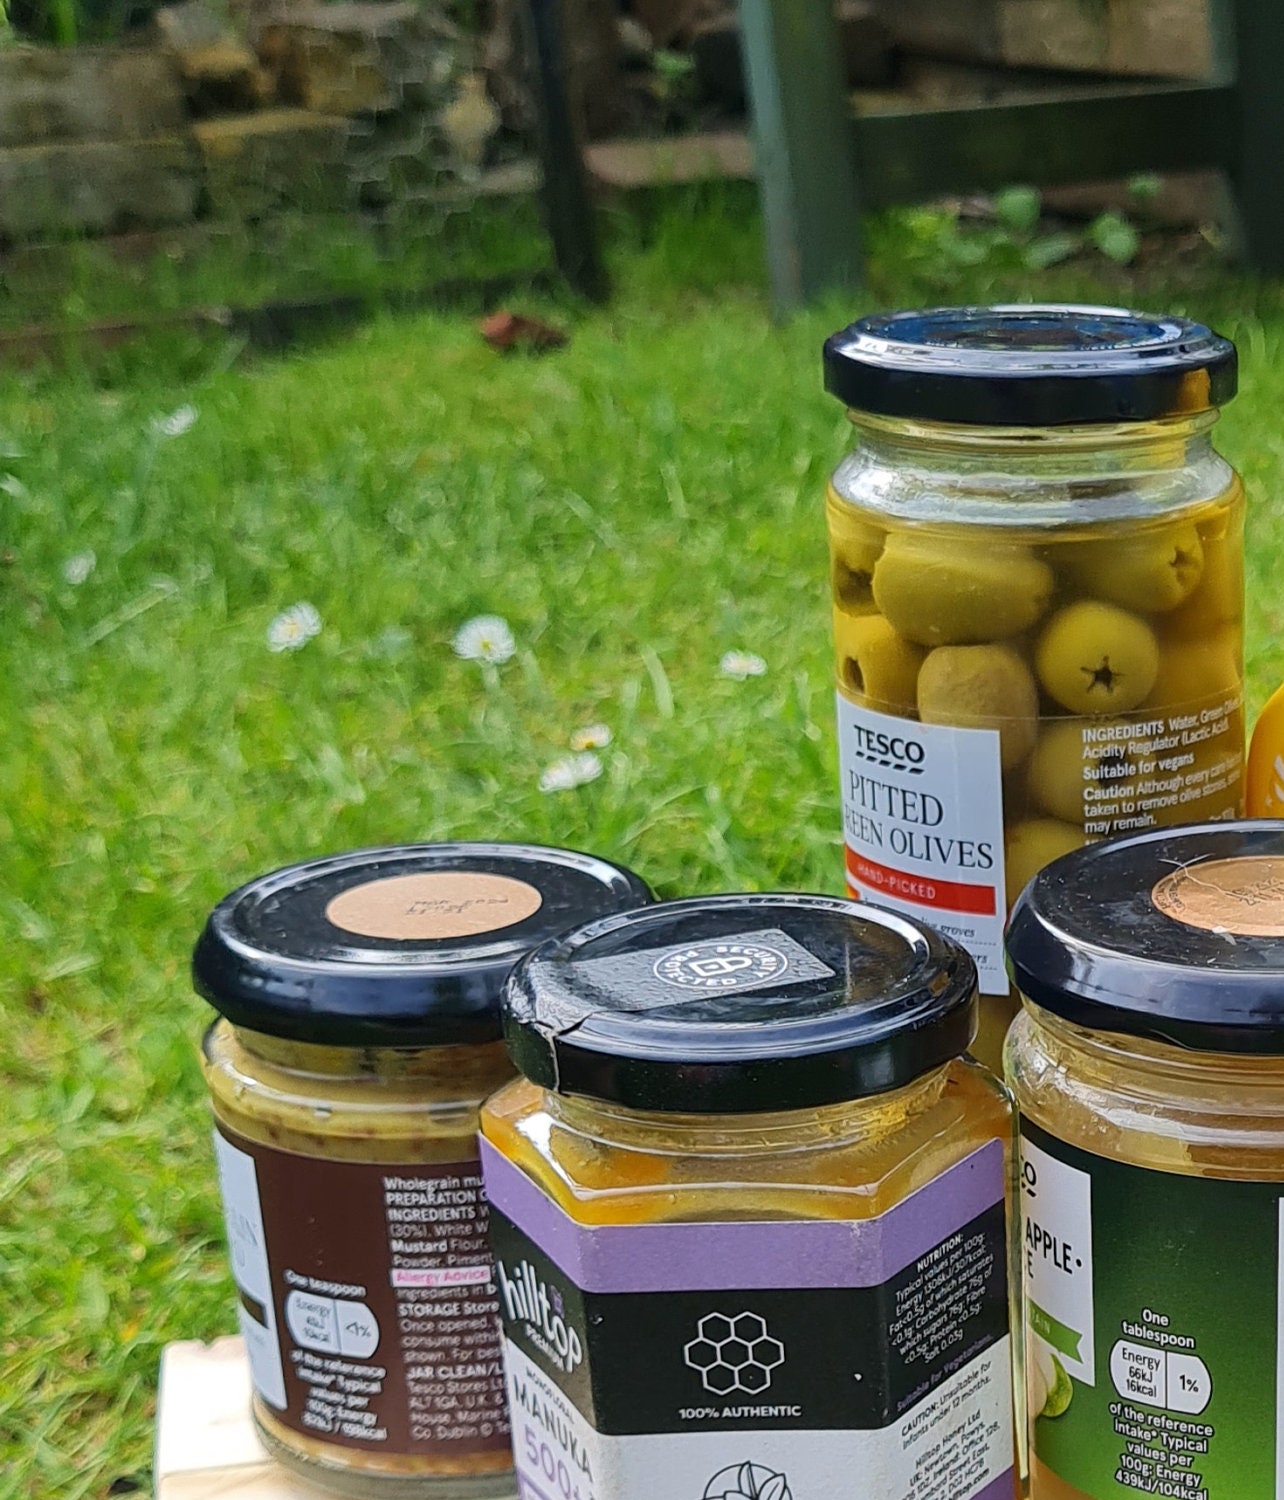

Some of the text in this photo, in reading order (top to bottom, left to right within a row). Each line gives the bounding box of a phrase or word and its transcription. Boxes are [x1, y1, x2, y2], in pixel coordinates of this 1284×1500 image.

[1082, 721, 1164, 742] INGREDIENTS
[854, 724, 925, 764] TESCO
[1083, 735, 1180, 759] Acidity Regulator
[1083, 752, 1194, 780] Suitable for vegans
[849, 769, 943, 827] PITTED
[1084, 785, 1134, 801] Caution
[1136, 775, 1184, 796] Although
[1084, 803, 1119, 818] taken
[1122, 800, 1134, 813] to
[1137, 794, 1178, 811] remove
[1084, 814, 1157, 835] may remain.
[846, 804, 994, 870] REEN OLIVES
[857, 863, 936, 899] HAND-PICKED
[664, 950, 737, 986] PROTECTED
[716, 945, 778, 978] SECURITY
[384, 1176, 460, 1193] Wholegrain
[385, 1191, 476, 1205] PREPARATION
[388, 1206, 476, 1222] INGREDIENTS
[391, 1239, 447, 1253] Mustard
[917, 1234, 963, 1273] NUTRITION:
[399, 1301, 500, 1317] STORAGE Store
[498, 1259, 583, 1373] hilltop
[1142, 1309, 1169, 1326] One
[1122, 1321, 1195, 1348] tablespoon
[1122, 1348, 1161, 1371] Energy
[1129, 1366, 1153, 1383] 66kJ
[1179, 1374, 1199, 1393] 1%
[1126, 1379, 1157, 1398] 16kcal
[678, 1405, 801, 1419] 100% AUTHENTIC
[1109, 1403, 1213, 1436] of the reference
[513, 1374, 593, 1483] MANUKA
[1160, 1432, 1207, 1452] Typical
[1127, 1442, 1193, 1467] values per
[1121, 1455, 1201, 1487] 100g: Energy
